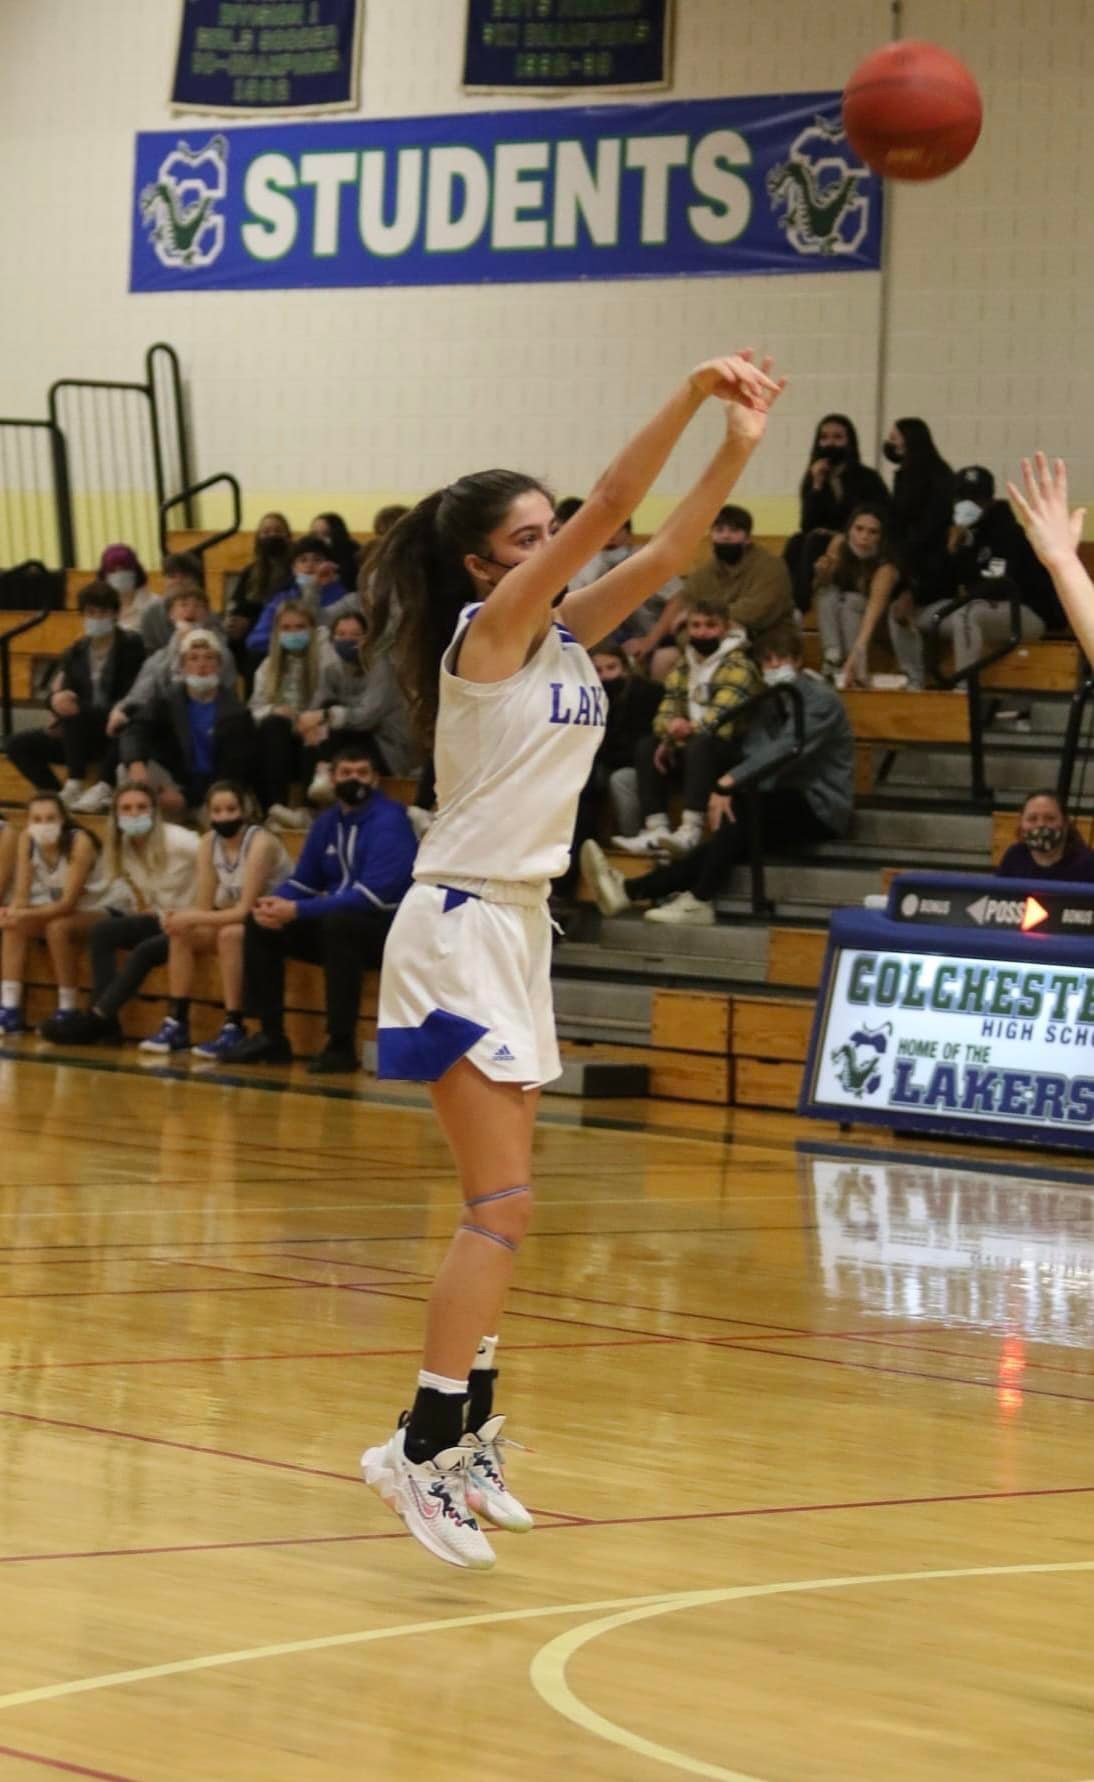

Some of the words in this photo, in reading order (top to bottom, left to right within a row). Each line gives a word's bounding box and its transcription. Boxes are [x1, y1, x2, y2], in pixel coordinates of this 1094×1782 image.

[241, 128, 753, 262] STUDENTS
[897, 1037, 937, 1059] HOME
[942, 1042, 962, 1060] OF
[965, 1044, 993, 1064] THE
[981, 1019, 1034, 1042] HIGH
[1044, 1024, 1094, 1048] SCH
[888, 1056, 1094, 1126] LAKERS
